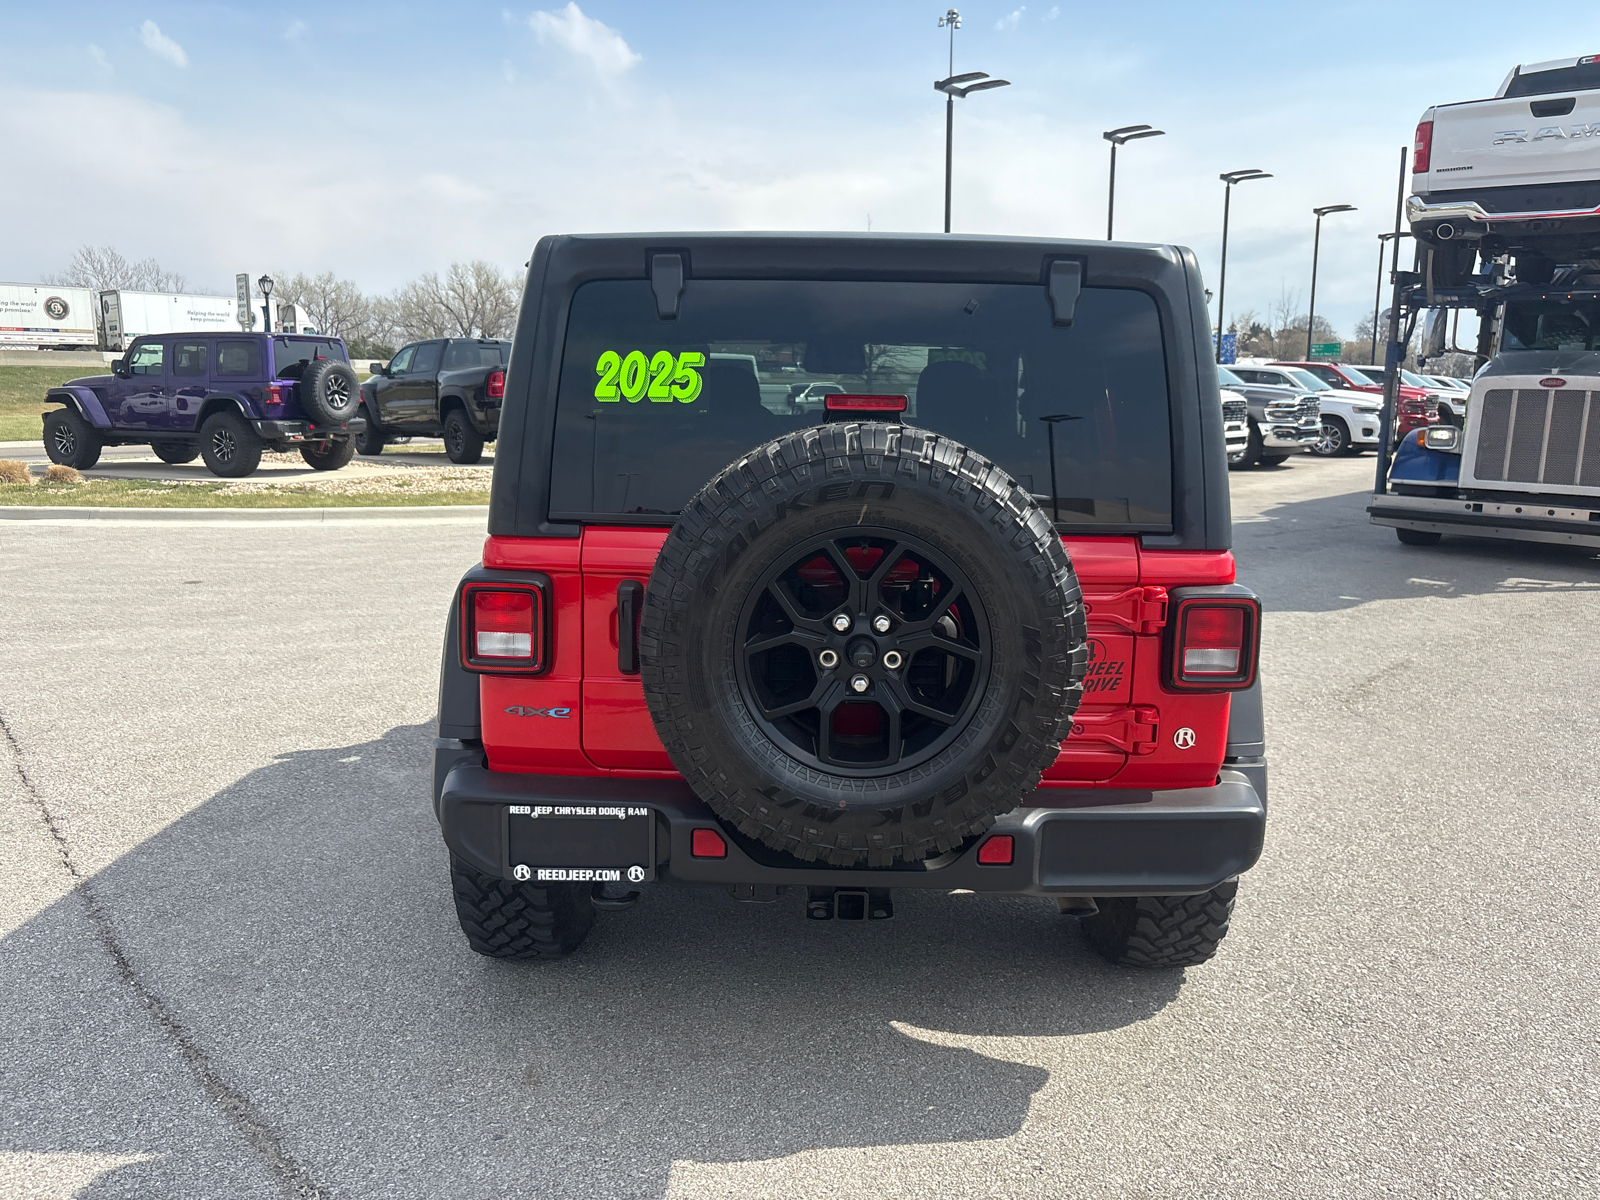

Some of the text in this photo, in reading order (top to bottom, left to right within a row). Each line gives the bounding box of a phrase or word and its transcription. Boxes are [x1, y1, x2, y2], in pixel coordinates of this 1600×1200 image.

[1493, 122, 1600, 145] RAM
[594, 350, 706, 403] 2025
[1085, 661, 1125, 676] HEEL
[1082, 677, 1122, 693] RIVE
[509, 805, 648, 816] REED JEEP CHRYSLER DODGE RAM
[537, 869, 620, 881] REEDJEEP.COM
